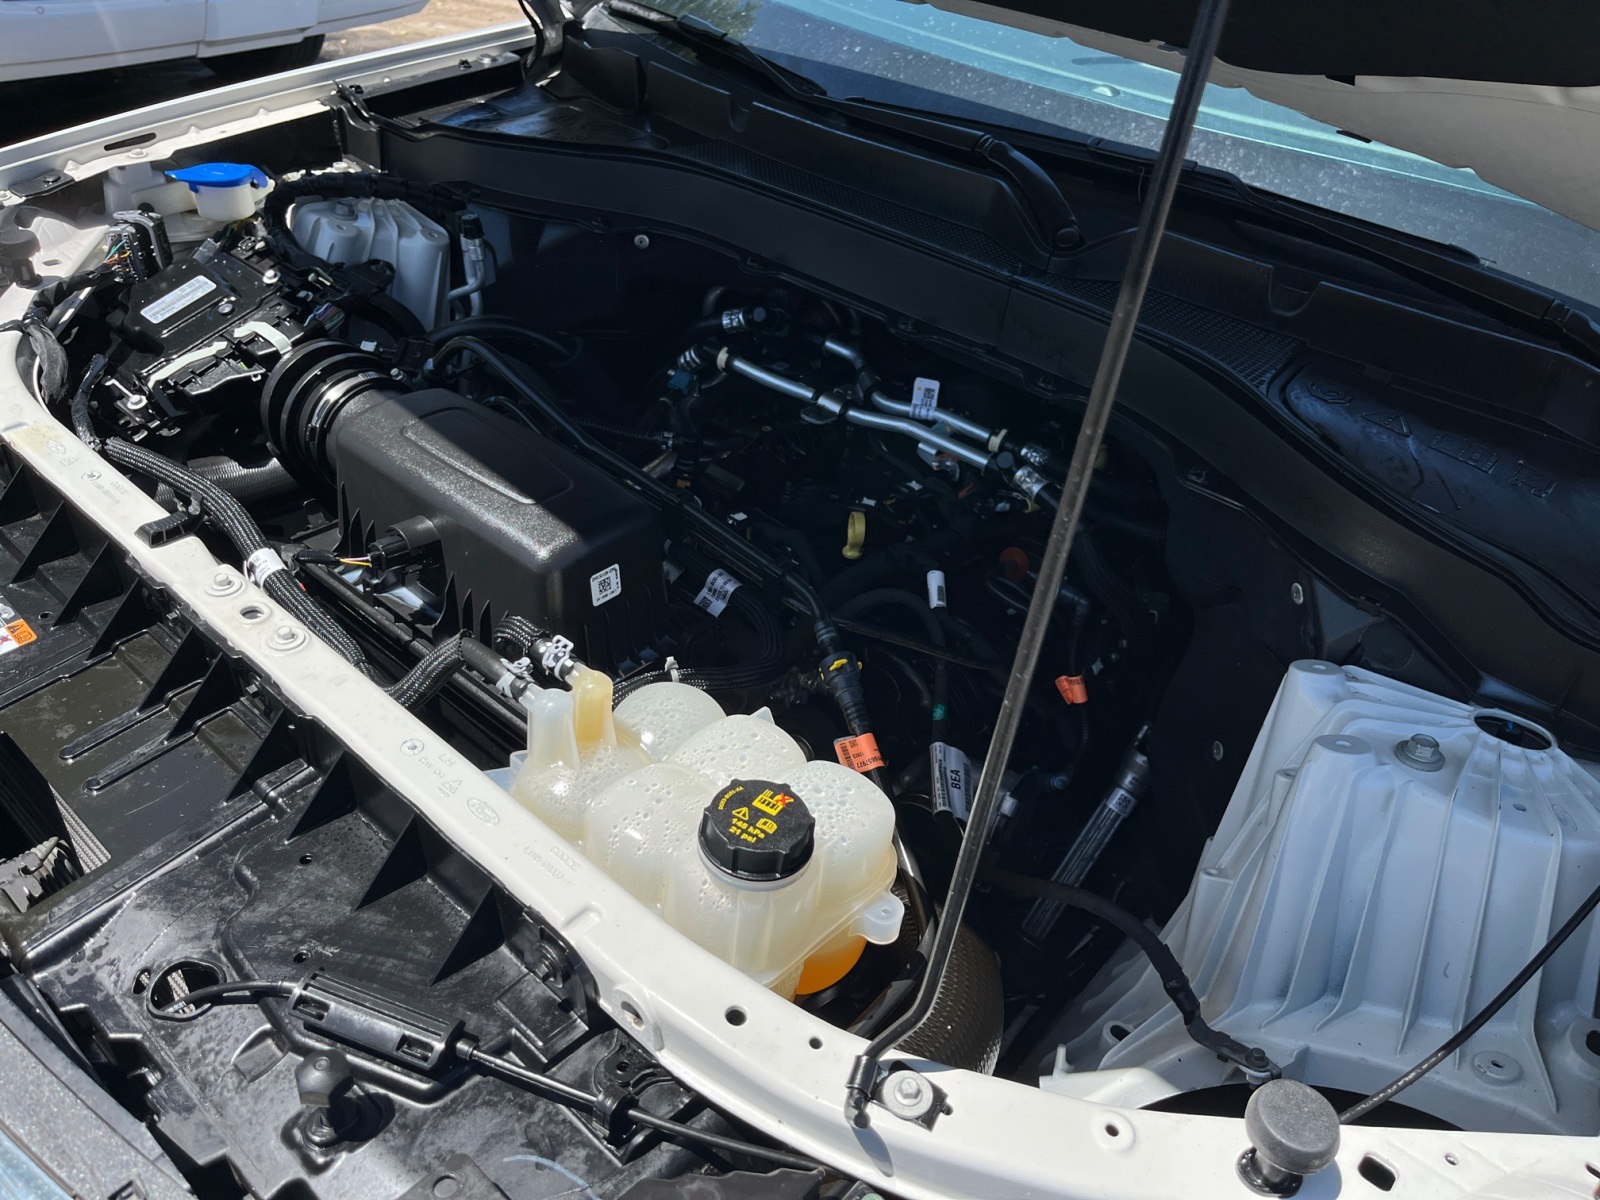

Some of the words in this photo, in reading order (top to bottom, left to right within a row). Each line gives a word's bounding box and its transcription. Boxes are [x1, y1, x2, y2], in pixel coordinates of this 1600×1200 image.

[950, 769, 961, 790] BEA
[729, 826, 741, 836] 21
[741, 834, 757, 843] psi
[732, 818, 748, 830] 145
[748, 826, 765, 839] kPa
